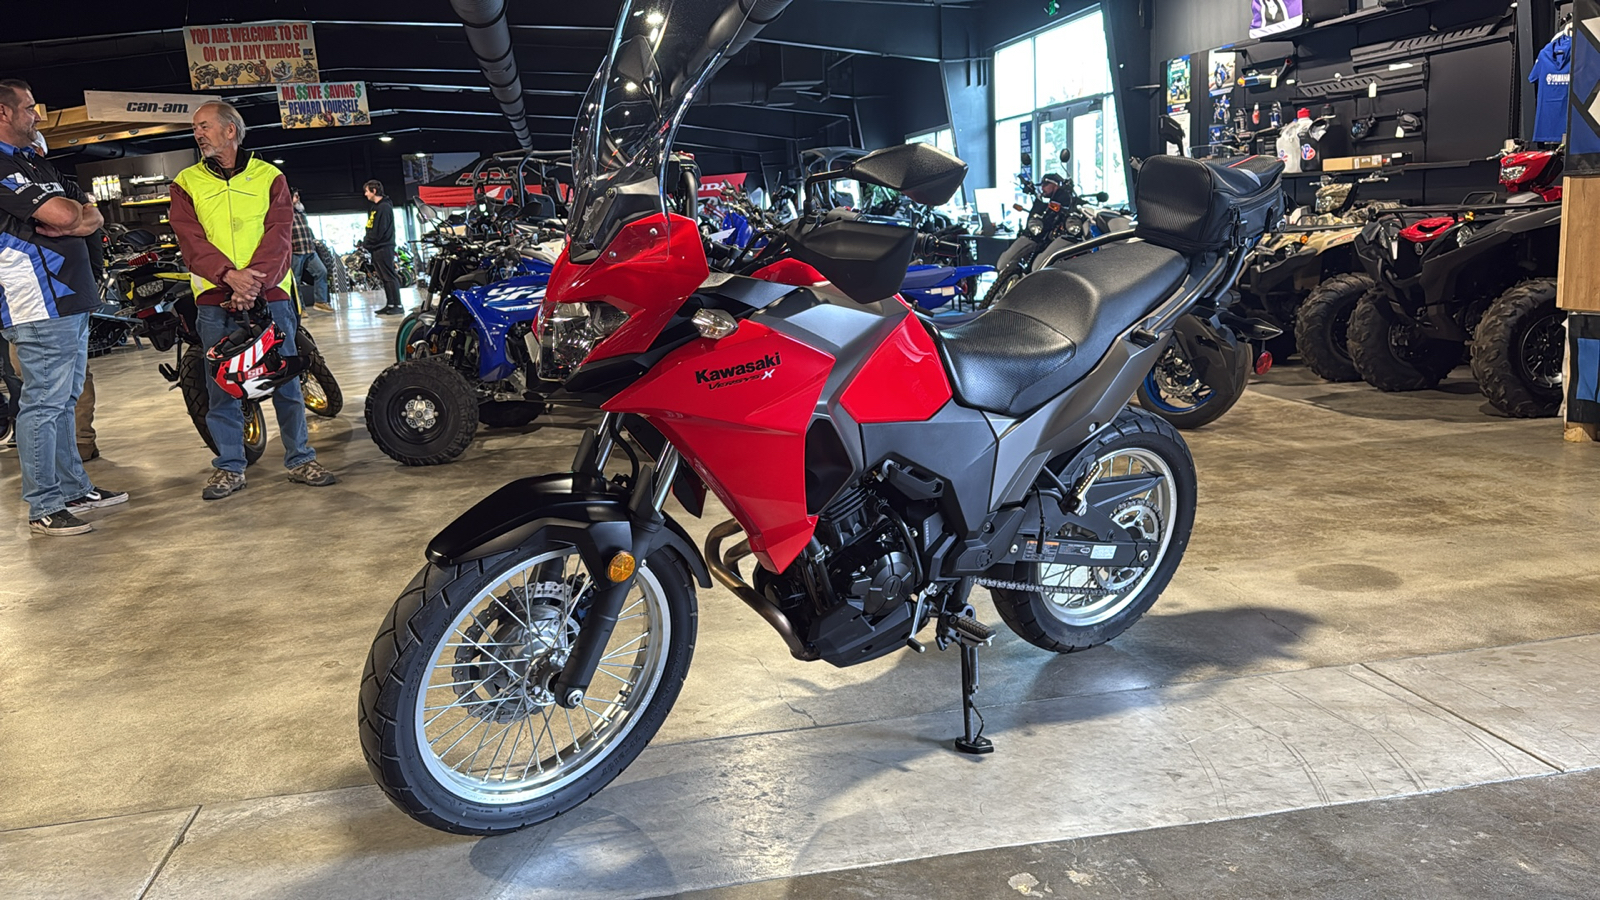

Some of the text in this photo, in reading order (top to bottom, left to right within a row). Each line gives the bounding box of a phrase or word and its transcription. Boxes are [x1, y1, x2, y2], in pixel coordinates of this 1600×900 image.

[190, 24, 308, 45] YOU ARE WELCOME TO SIT
[203, 46, 217, 62] ON
[218, 48, 230, 61] or
[231, 45, 242, 60] IN
[242, 44, 261, 60] ANY
[262, 42, 302, 59] VEHICLE
[281, 84, 322, 101] MA$$IVE
[324, 82, 362, 100] $AVING$
[126, 101, 189, 113] can-am
[288, 100, 322, 116] REWARD
[322, 98, 359, 114] YOURSELF
[695, 351, 781, 384] Kawasaki
